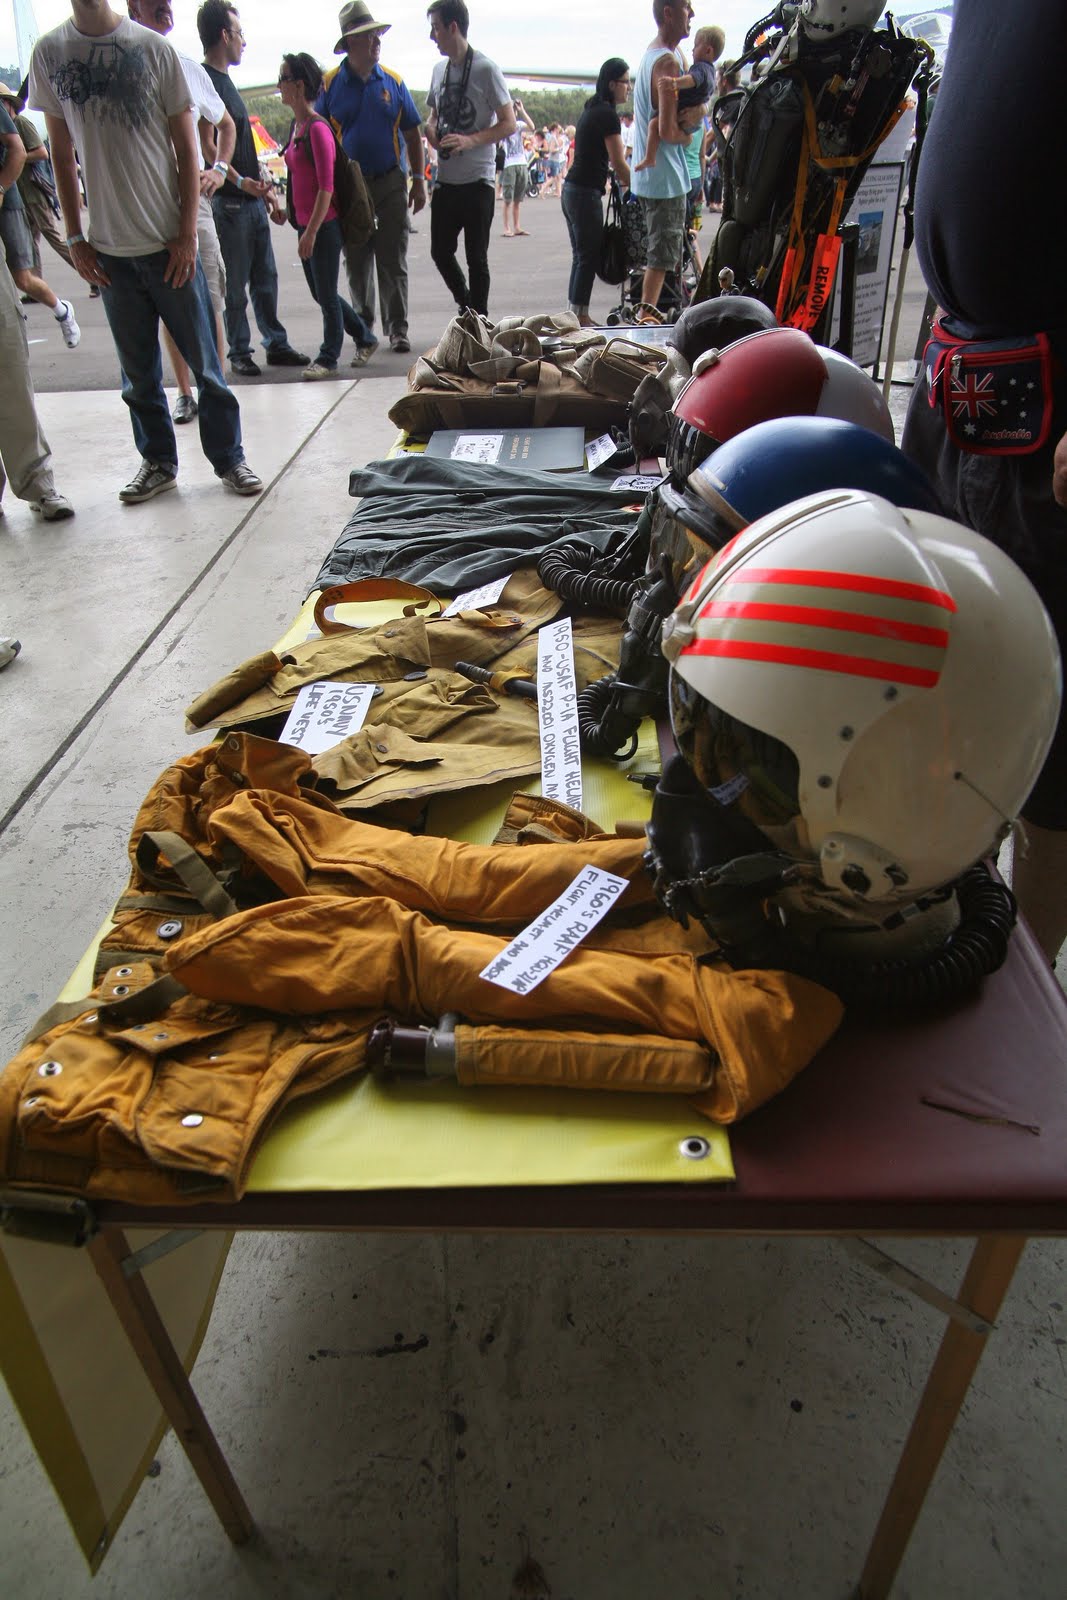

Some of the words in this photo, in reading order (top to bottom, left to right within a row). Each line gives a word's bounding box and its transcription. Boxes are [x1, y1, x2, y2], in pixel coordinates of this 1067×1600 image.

[808, 265, 829, 318] REMOVE
[983, 428, 1032, 439] Australia
[541, 655, 554, 673] AND
[305, 684, 326, 709] LIFE
[289, 711, 314, 745] VEST
[563, 725, 579, 766] FLIGHT
[542, 733, 557, 778] OXYGEN
[565, 870, 599, 906] FLIGHT
[529, 904, 568, 940] HELMET
[553, 920, 588, 956] RAAF
[507, 940, 529, 958] AND
